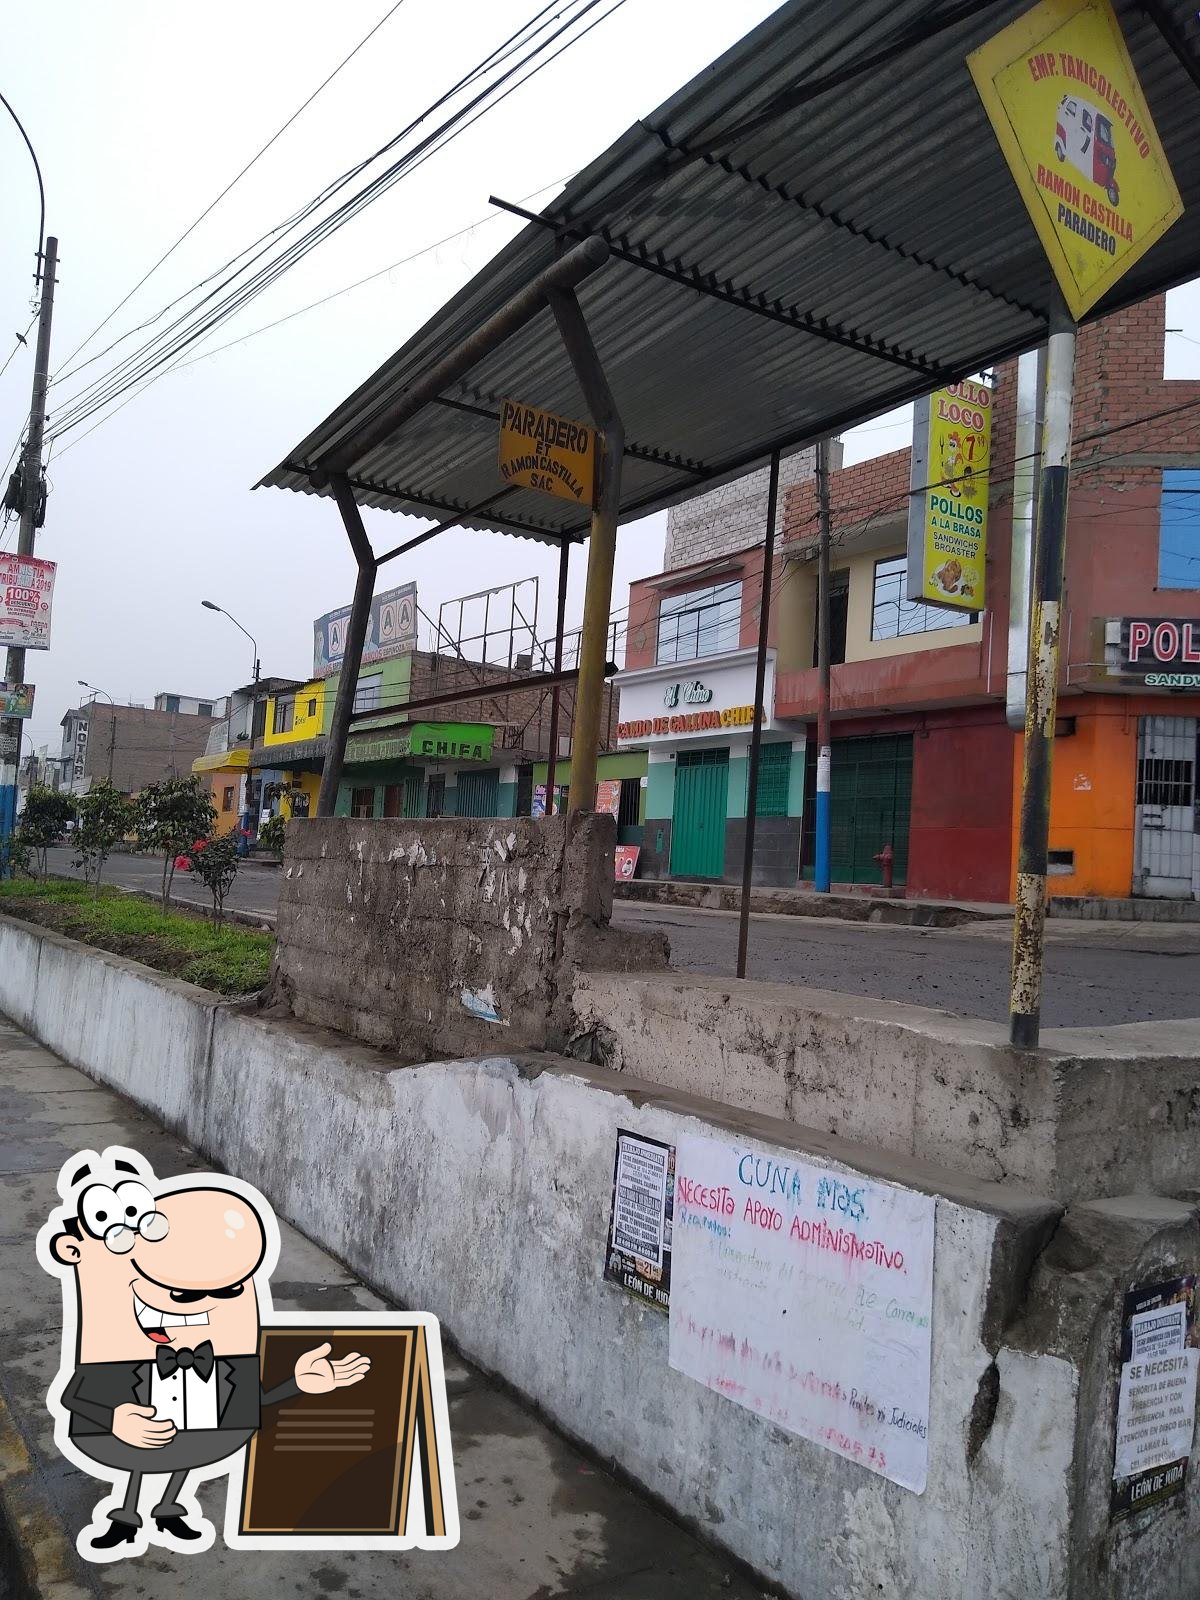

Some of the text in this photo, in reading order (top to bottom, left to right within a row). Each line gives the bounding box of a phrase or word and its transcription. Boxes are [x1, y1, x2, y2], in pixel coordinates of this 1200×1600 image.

[1027, 52, 1150, 160] EMP. TAXICOLECTIVO
[1036, 163, 1133, 243] RAMON CASTILLA
[1057, 203, 1117, 256] PARADERO
[937, 398, 985, 432] LOCO
[502, 402, 588, 454] PARADERO
[536, 440, 552, 457] ET
[501, 455, 584, 498] RAMON CASTILLA
[931, 495, 983, 525] POLLOS
[931, 516, 982, 539] A LA BRASA
[933, 531, 979, 551] SANDWICHS
[934, 541, 976, 560] BROASTER
[8, 588, 40, 603] 100%
[652, 716, 670, 736] DE
[669, 710, 722, 733] GALLINA
[74, 721, 88, 780] NOTAR
[422, 740, 482, 759] CHIFA
[743, 1197, 783, 1231] APOYO
[643, 1282, 655, 1299] DE
[1129, 1356, 1189, 1380] SE NECESITA
[1158, 1380, 1166, 1391] DE
[1153, 1473, 1165, 1491] DE
